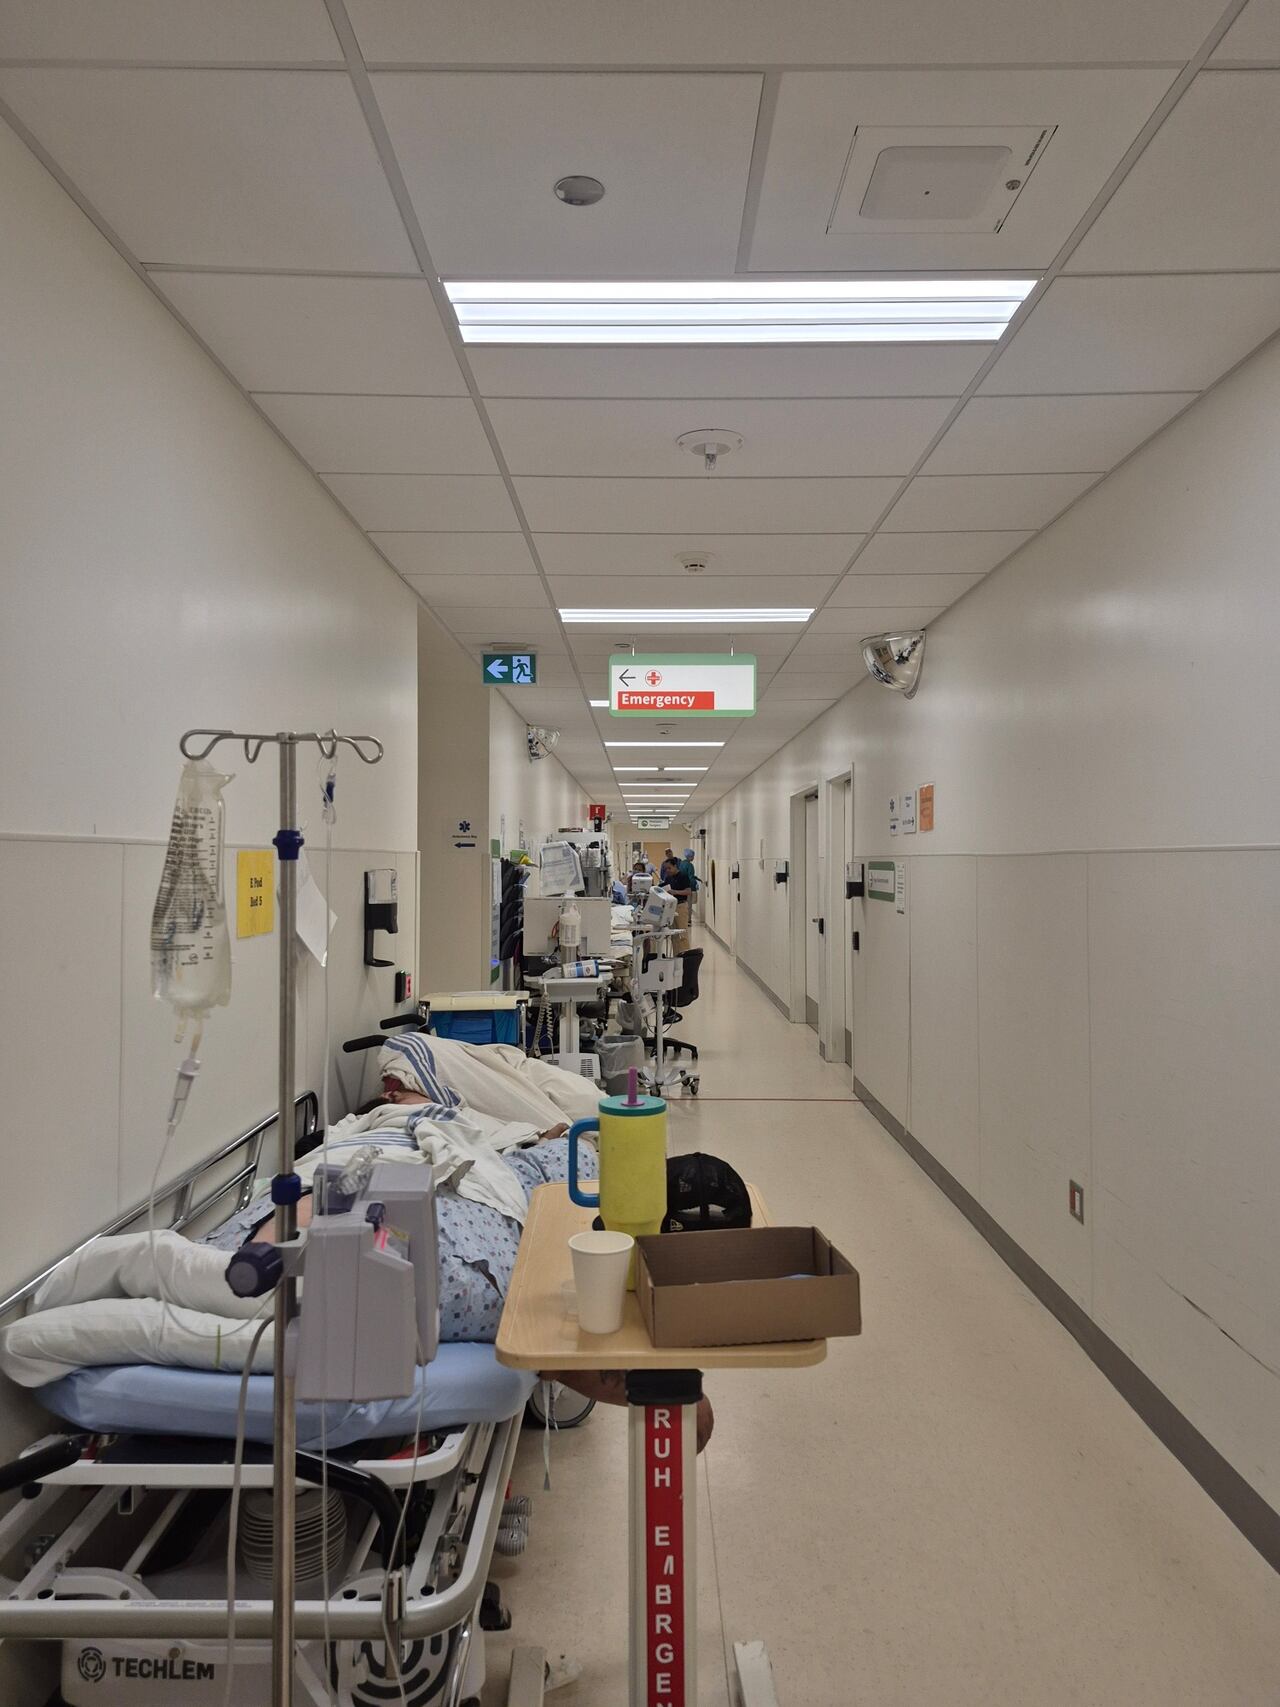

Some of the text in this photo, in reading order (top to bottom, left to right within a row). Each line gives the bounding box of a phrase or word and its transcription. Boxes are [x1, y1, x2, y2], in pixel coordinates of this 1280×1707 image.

[621, 693, 695, 707] Emergency
[653, 1408, 672, 1488] RUH
[111, 1657, 215, 1680] TECHLEM
